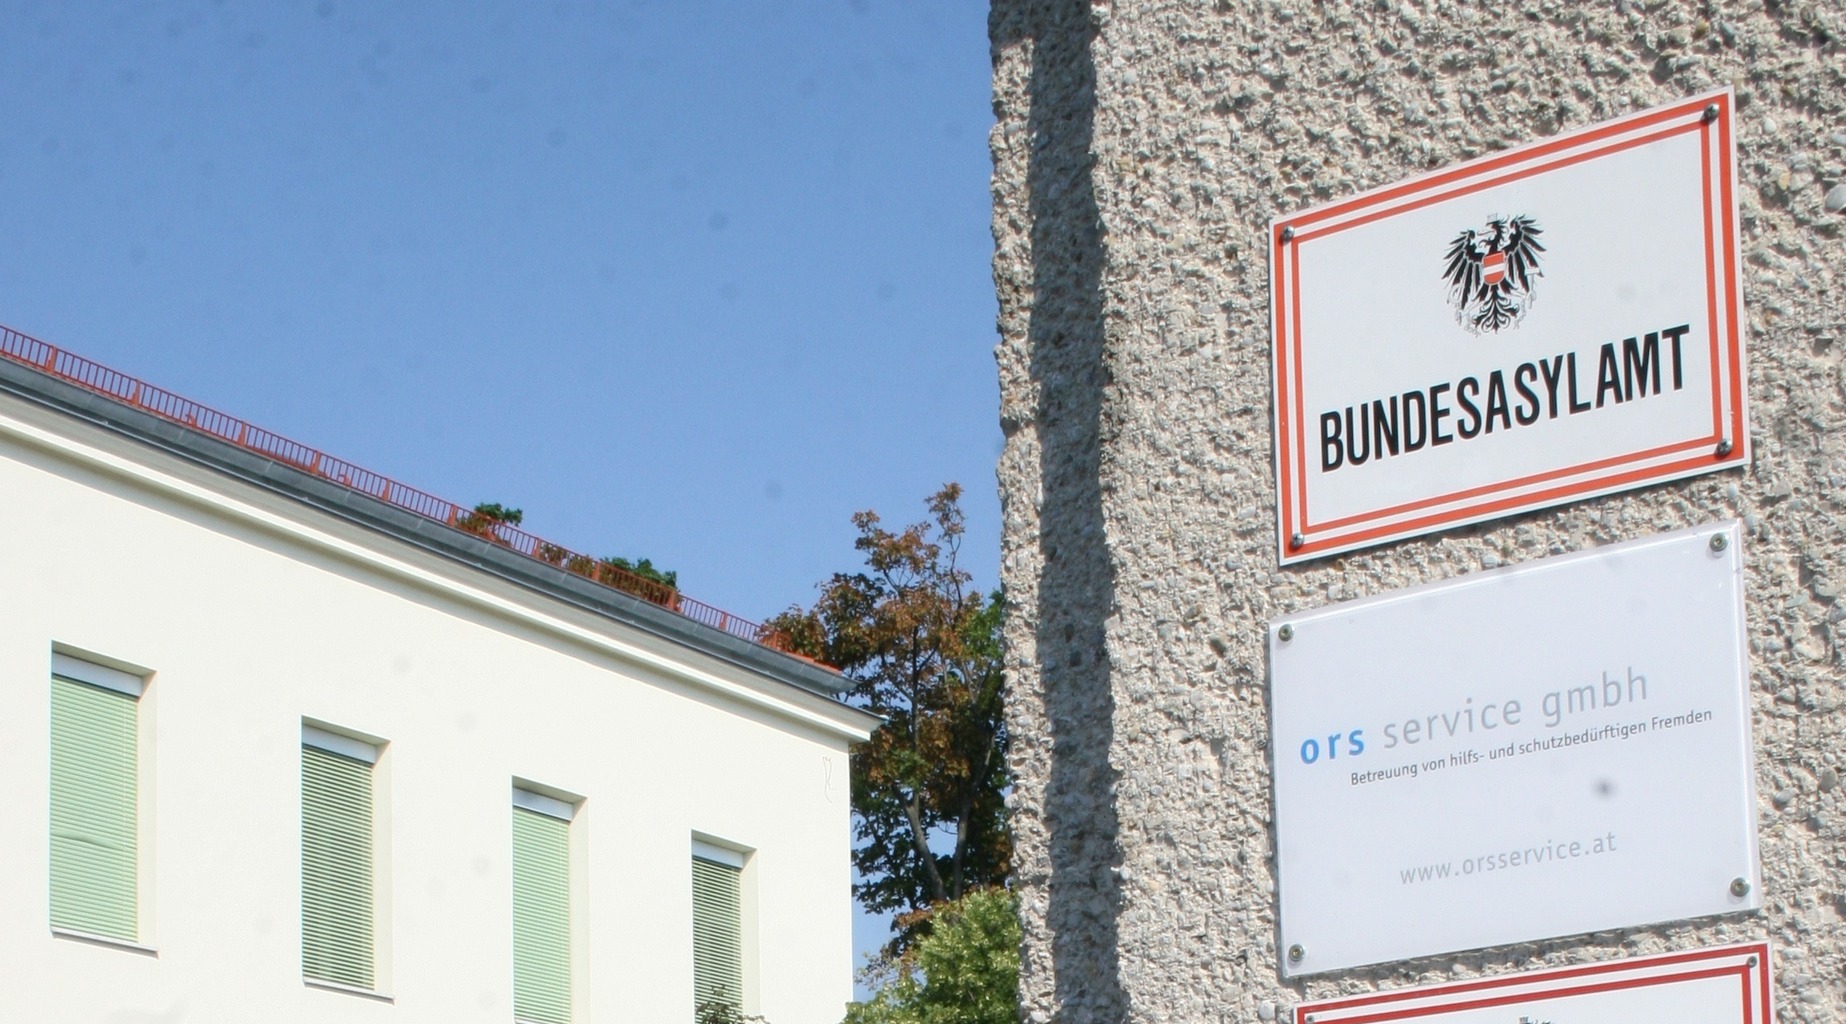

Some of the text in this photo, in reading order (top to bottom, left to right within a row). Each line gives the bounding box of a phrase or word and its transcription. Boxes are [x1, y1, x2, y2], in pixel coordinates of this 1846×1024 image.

[1320, 323, 1690, 473] BUNDESASYLAMT
[1299, 666, 1647, 765] ors service gmbh
[1350, 709, 1713, 786] Betreuung von hilfs- und schutzbedürftigen Fremden
[1400, 831, 1618, 885] www.orsservice.at
